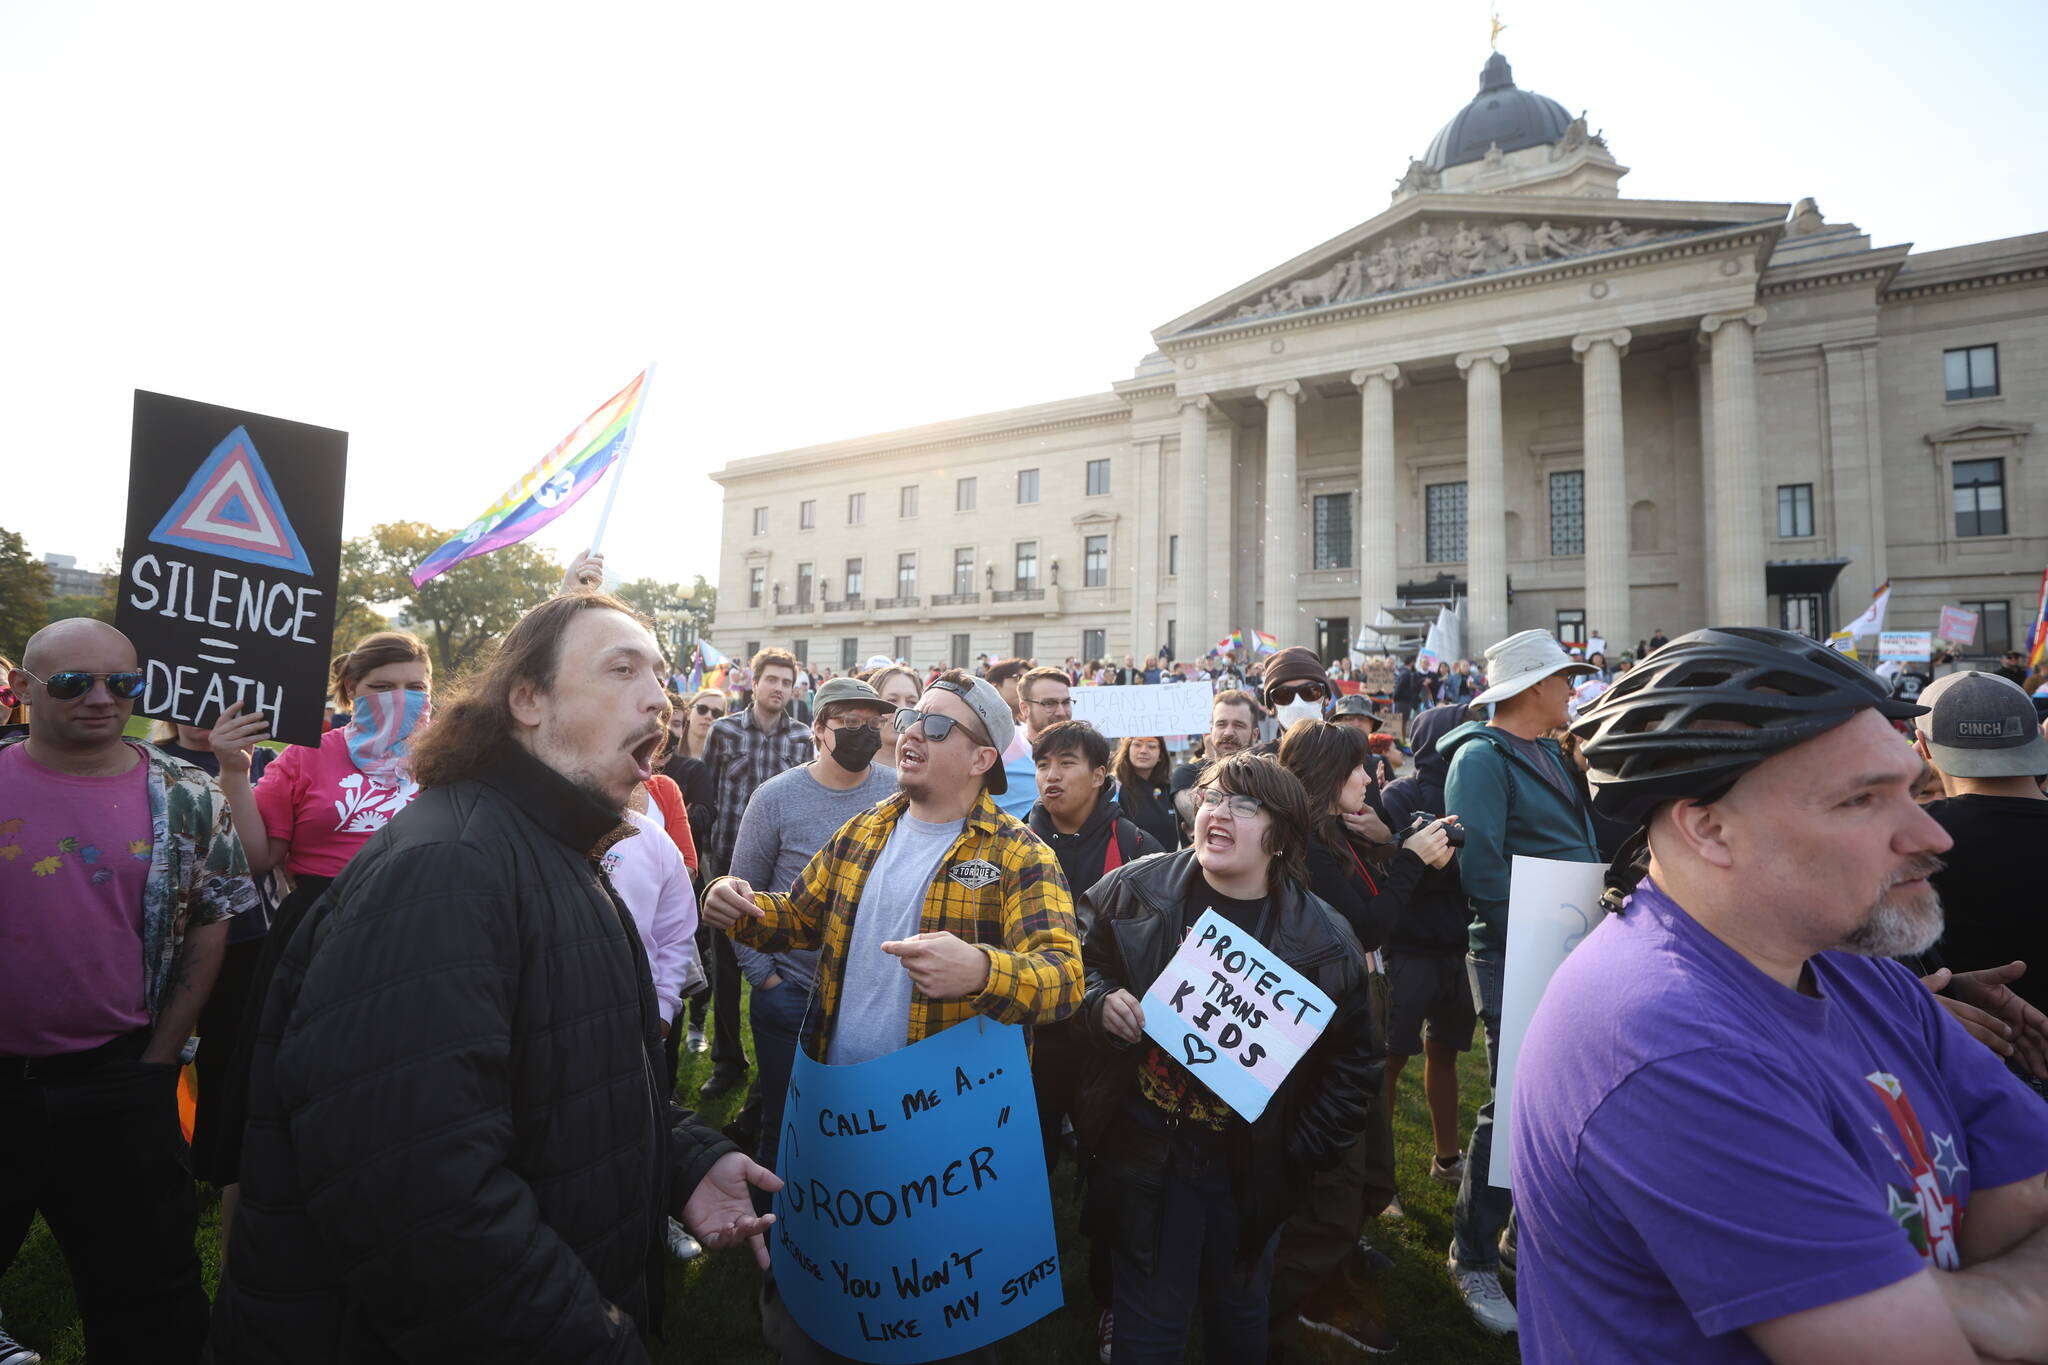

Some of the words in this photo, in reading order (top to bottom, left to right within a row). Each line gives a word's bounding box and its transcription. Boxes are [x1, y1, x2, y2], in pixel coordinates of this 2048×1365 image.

[130, 554, 322, 644] SILENCE
[143, 659, 282, 738] DEATH
[1076, 690, 1145, 713] TRANS
[1156, 687, 1208, 713] LIVES
[1959, 722, 2001, 735] CINCH
[960, 867, 990, 877] TORQUE
[1197, 924, 1321, 1025] PROTECT
[1206, 971, 1269, 1029] TRANS
[1169, 980, 1266, 1067] KIDS
[819, 1109, 887, 1137] CALL
[943, 1291, 980, 1328] MY
[1000, 1256, 1056, 1305] STATS
